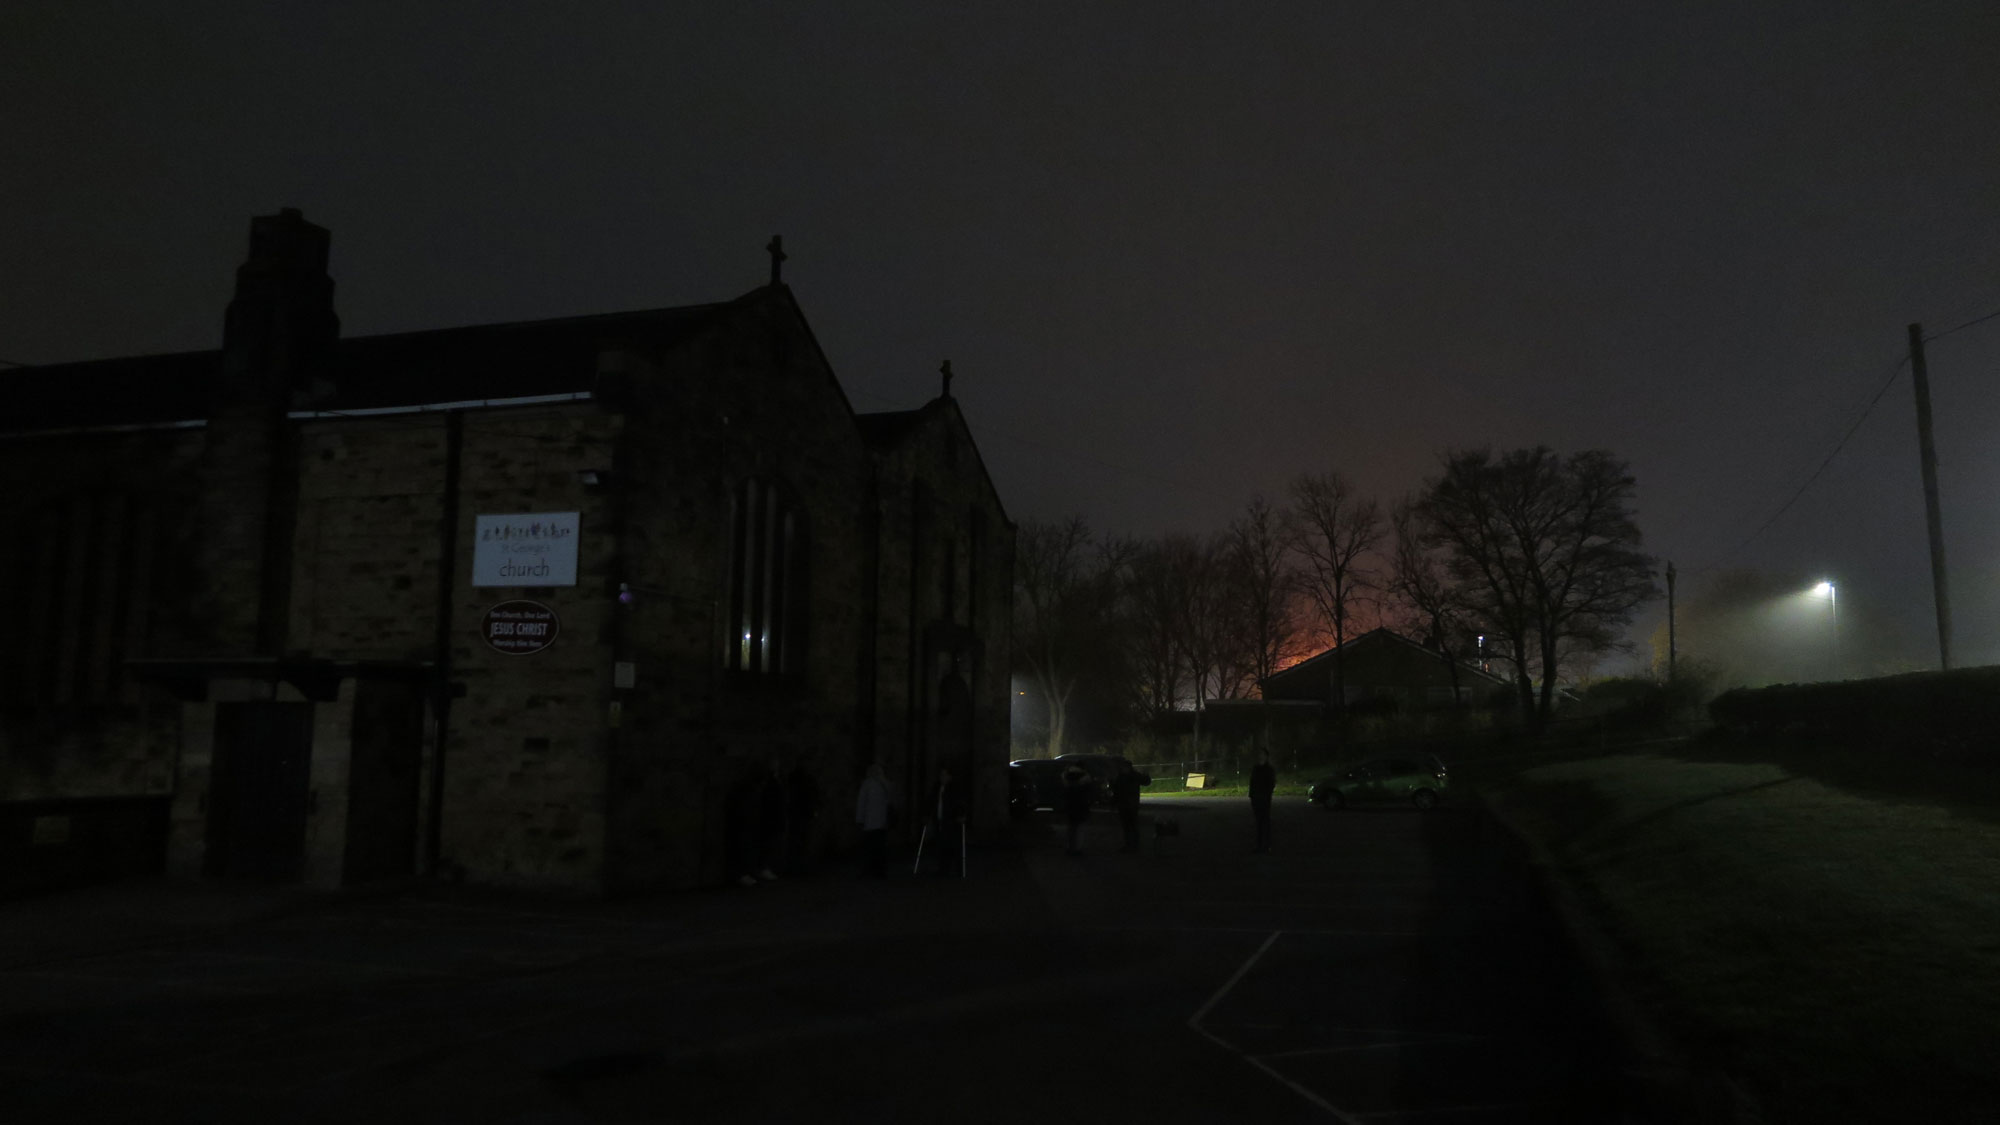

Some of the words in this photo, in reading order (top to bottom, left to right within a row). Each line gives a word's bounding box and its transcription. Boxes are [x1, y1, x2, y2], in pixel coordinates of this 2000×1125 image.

[499, 557, 550, 577] church
[489, 622, 514, 637] JESUS
[516, 622, 548, 636] CHRIST
